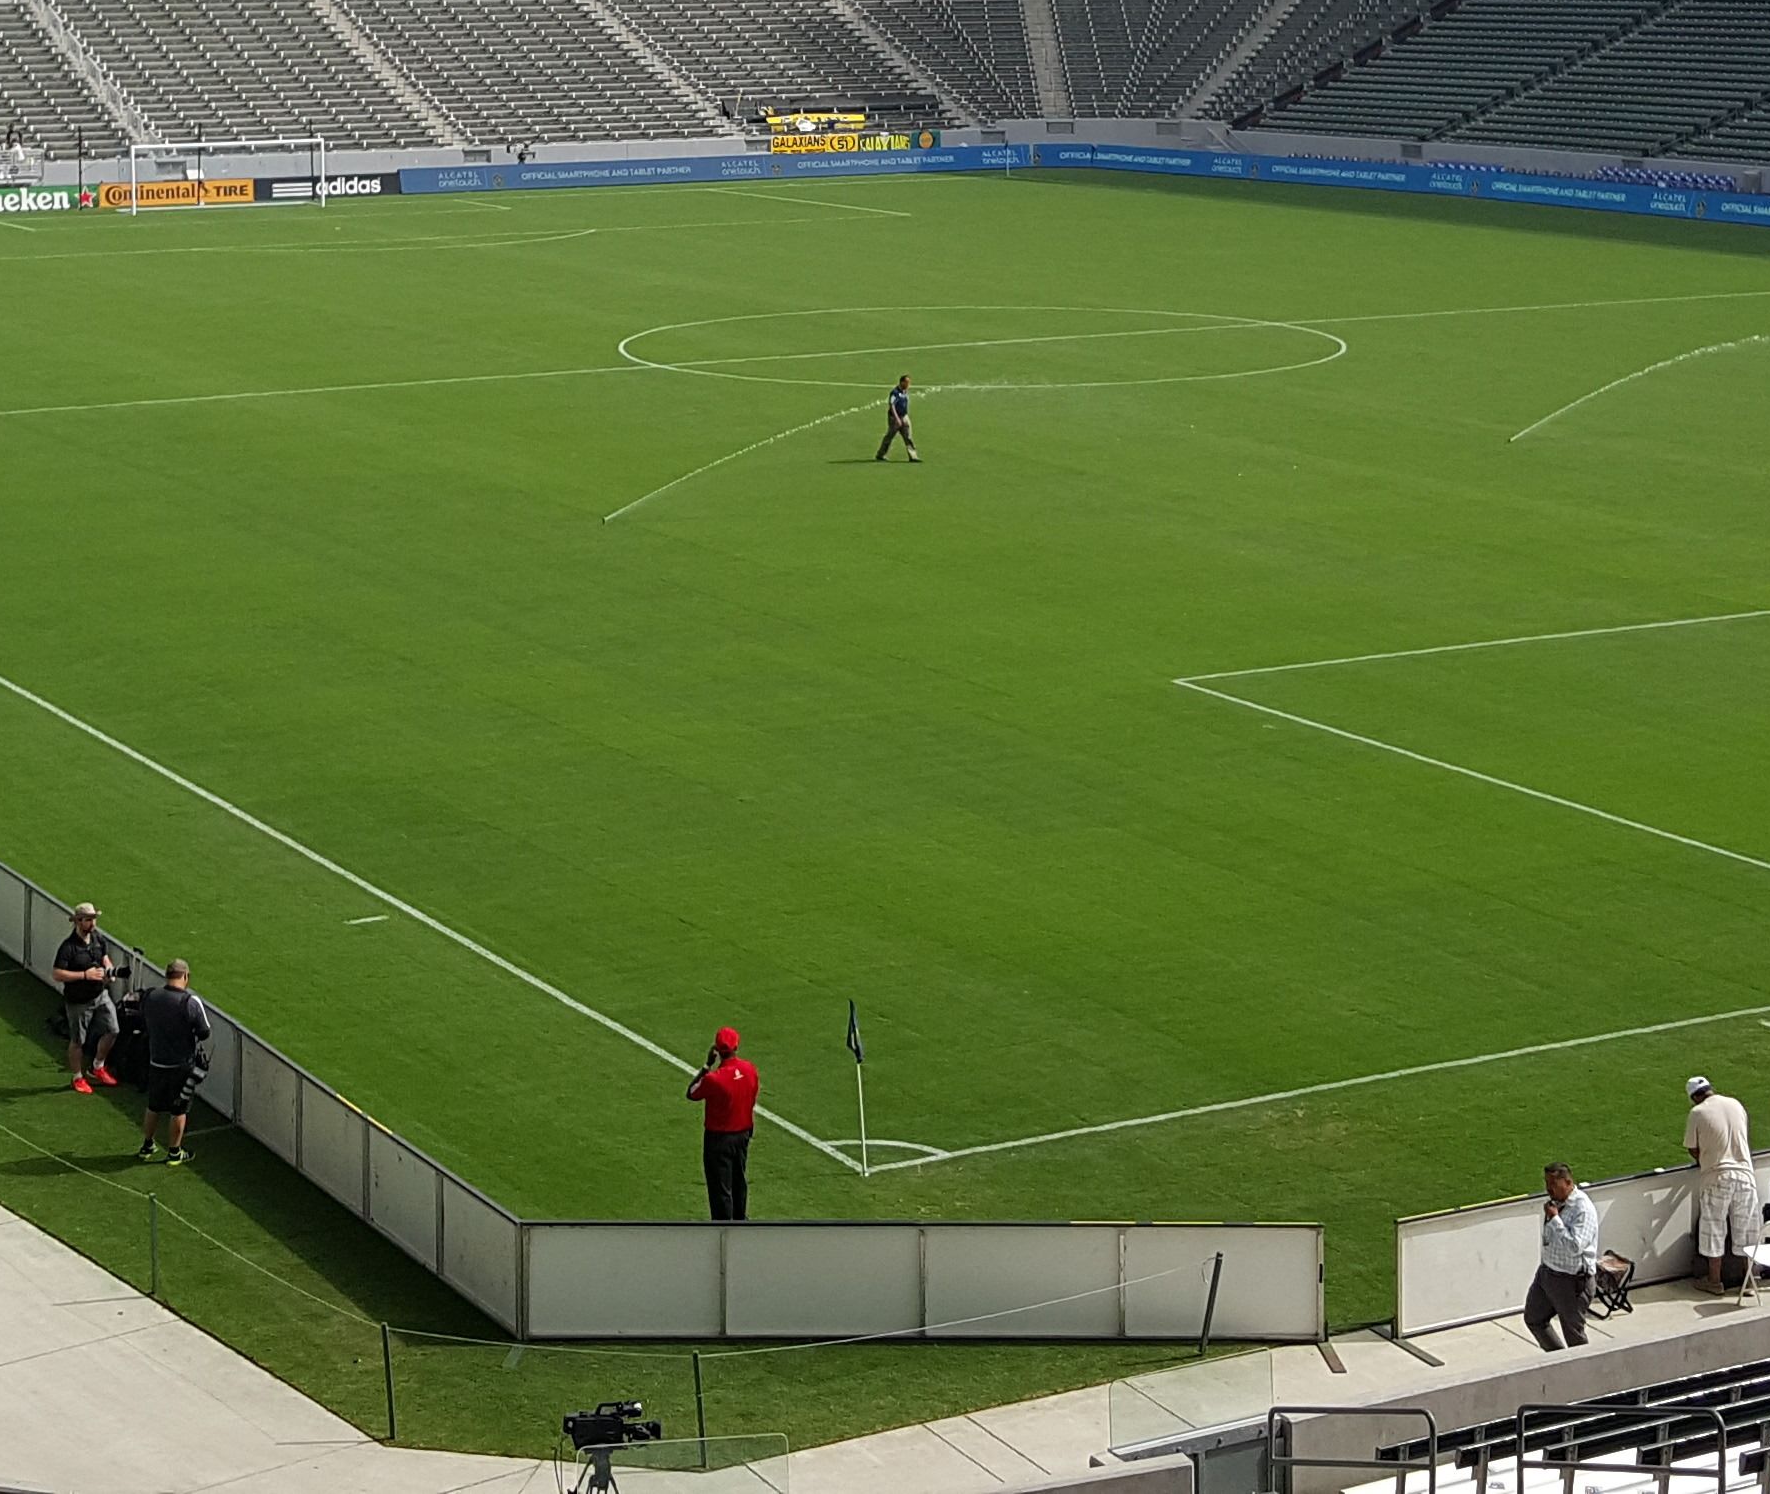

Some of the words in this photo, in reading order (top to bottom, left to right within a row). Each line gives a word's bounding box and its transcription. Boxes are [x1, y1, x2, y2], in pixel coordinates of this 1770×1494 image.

[772, 135, 826, 148] GALAXIANS
[105, 183, 196, 205] Continental
[213, 185, 249, 198] TIRE
[315, 177, 382, 195] adidas
